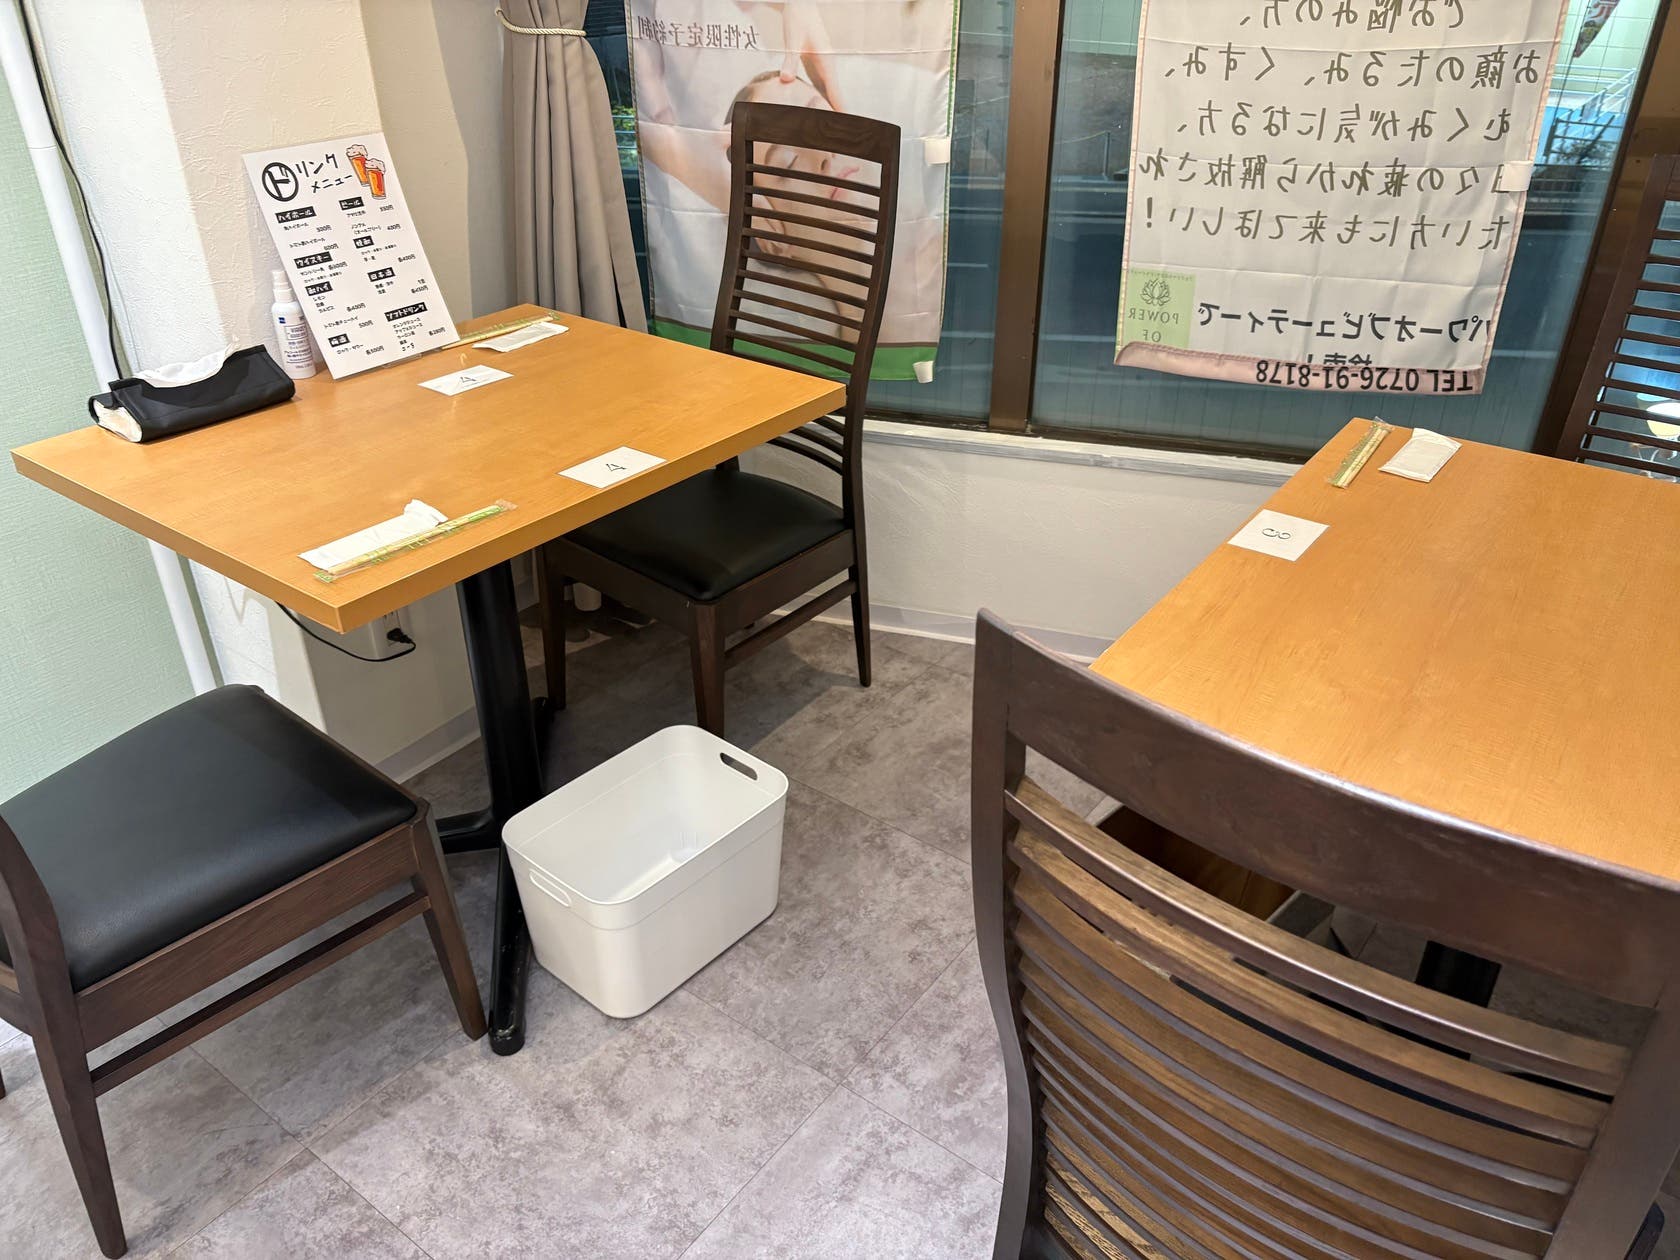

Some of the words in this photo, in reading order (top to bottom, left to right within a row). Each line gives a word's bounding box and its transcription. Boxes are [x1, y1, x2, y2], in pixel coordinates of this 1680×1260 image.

[311, 174, 354, 193] メニュー
[369, 268, 394, 281] 日本酒
[386, 303, 426, 320] ソフトドリンク
[1256, 359, 1420, 392] 0726-91-8178
[1426, 370, 1473, 393] TEL
